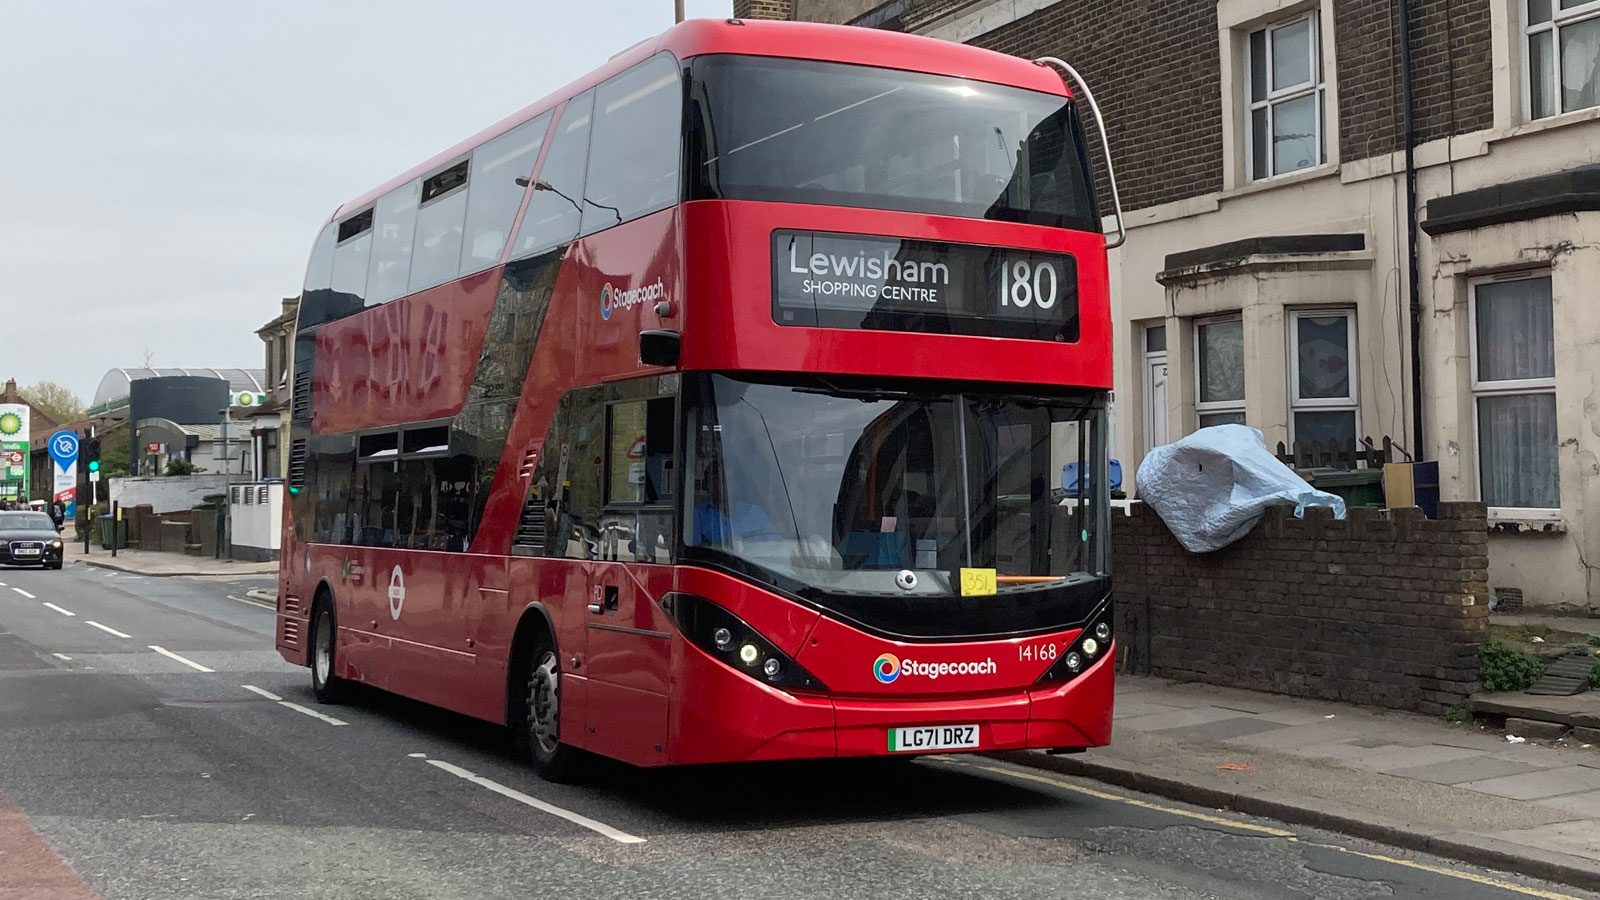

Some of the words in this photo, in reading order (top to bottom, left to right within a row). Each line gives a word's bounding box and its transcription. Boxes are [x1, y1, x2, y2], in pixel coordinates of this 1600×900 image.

[790, 238, 949, 285] Lewisham
[1001, 260, 1057, 309] 180
[613, 276, 664, 311] Stagecoach
[803, 279, 877, 298] SHOPPING
[881, 286, 937, 303] CENTRE
[1019, 643, 1057, 662] 14168
[900, 657, 997, 680] Stagecoach
[902, 729, 938, 748] LG71
[943, 727, 974, 745] DRZ
